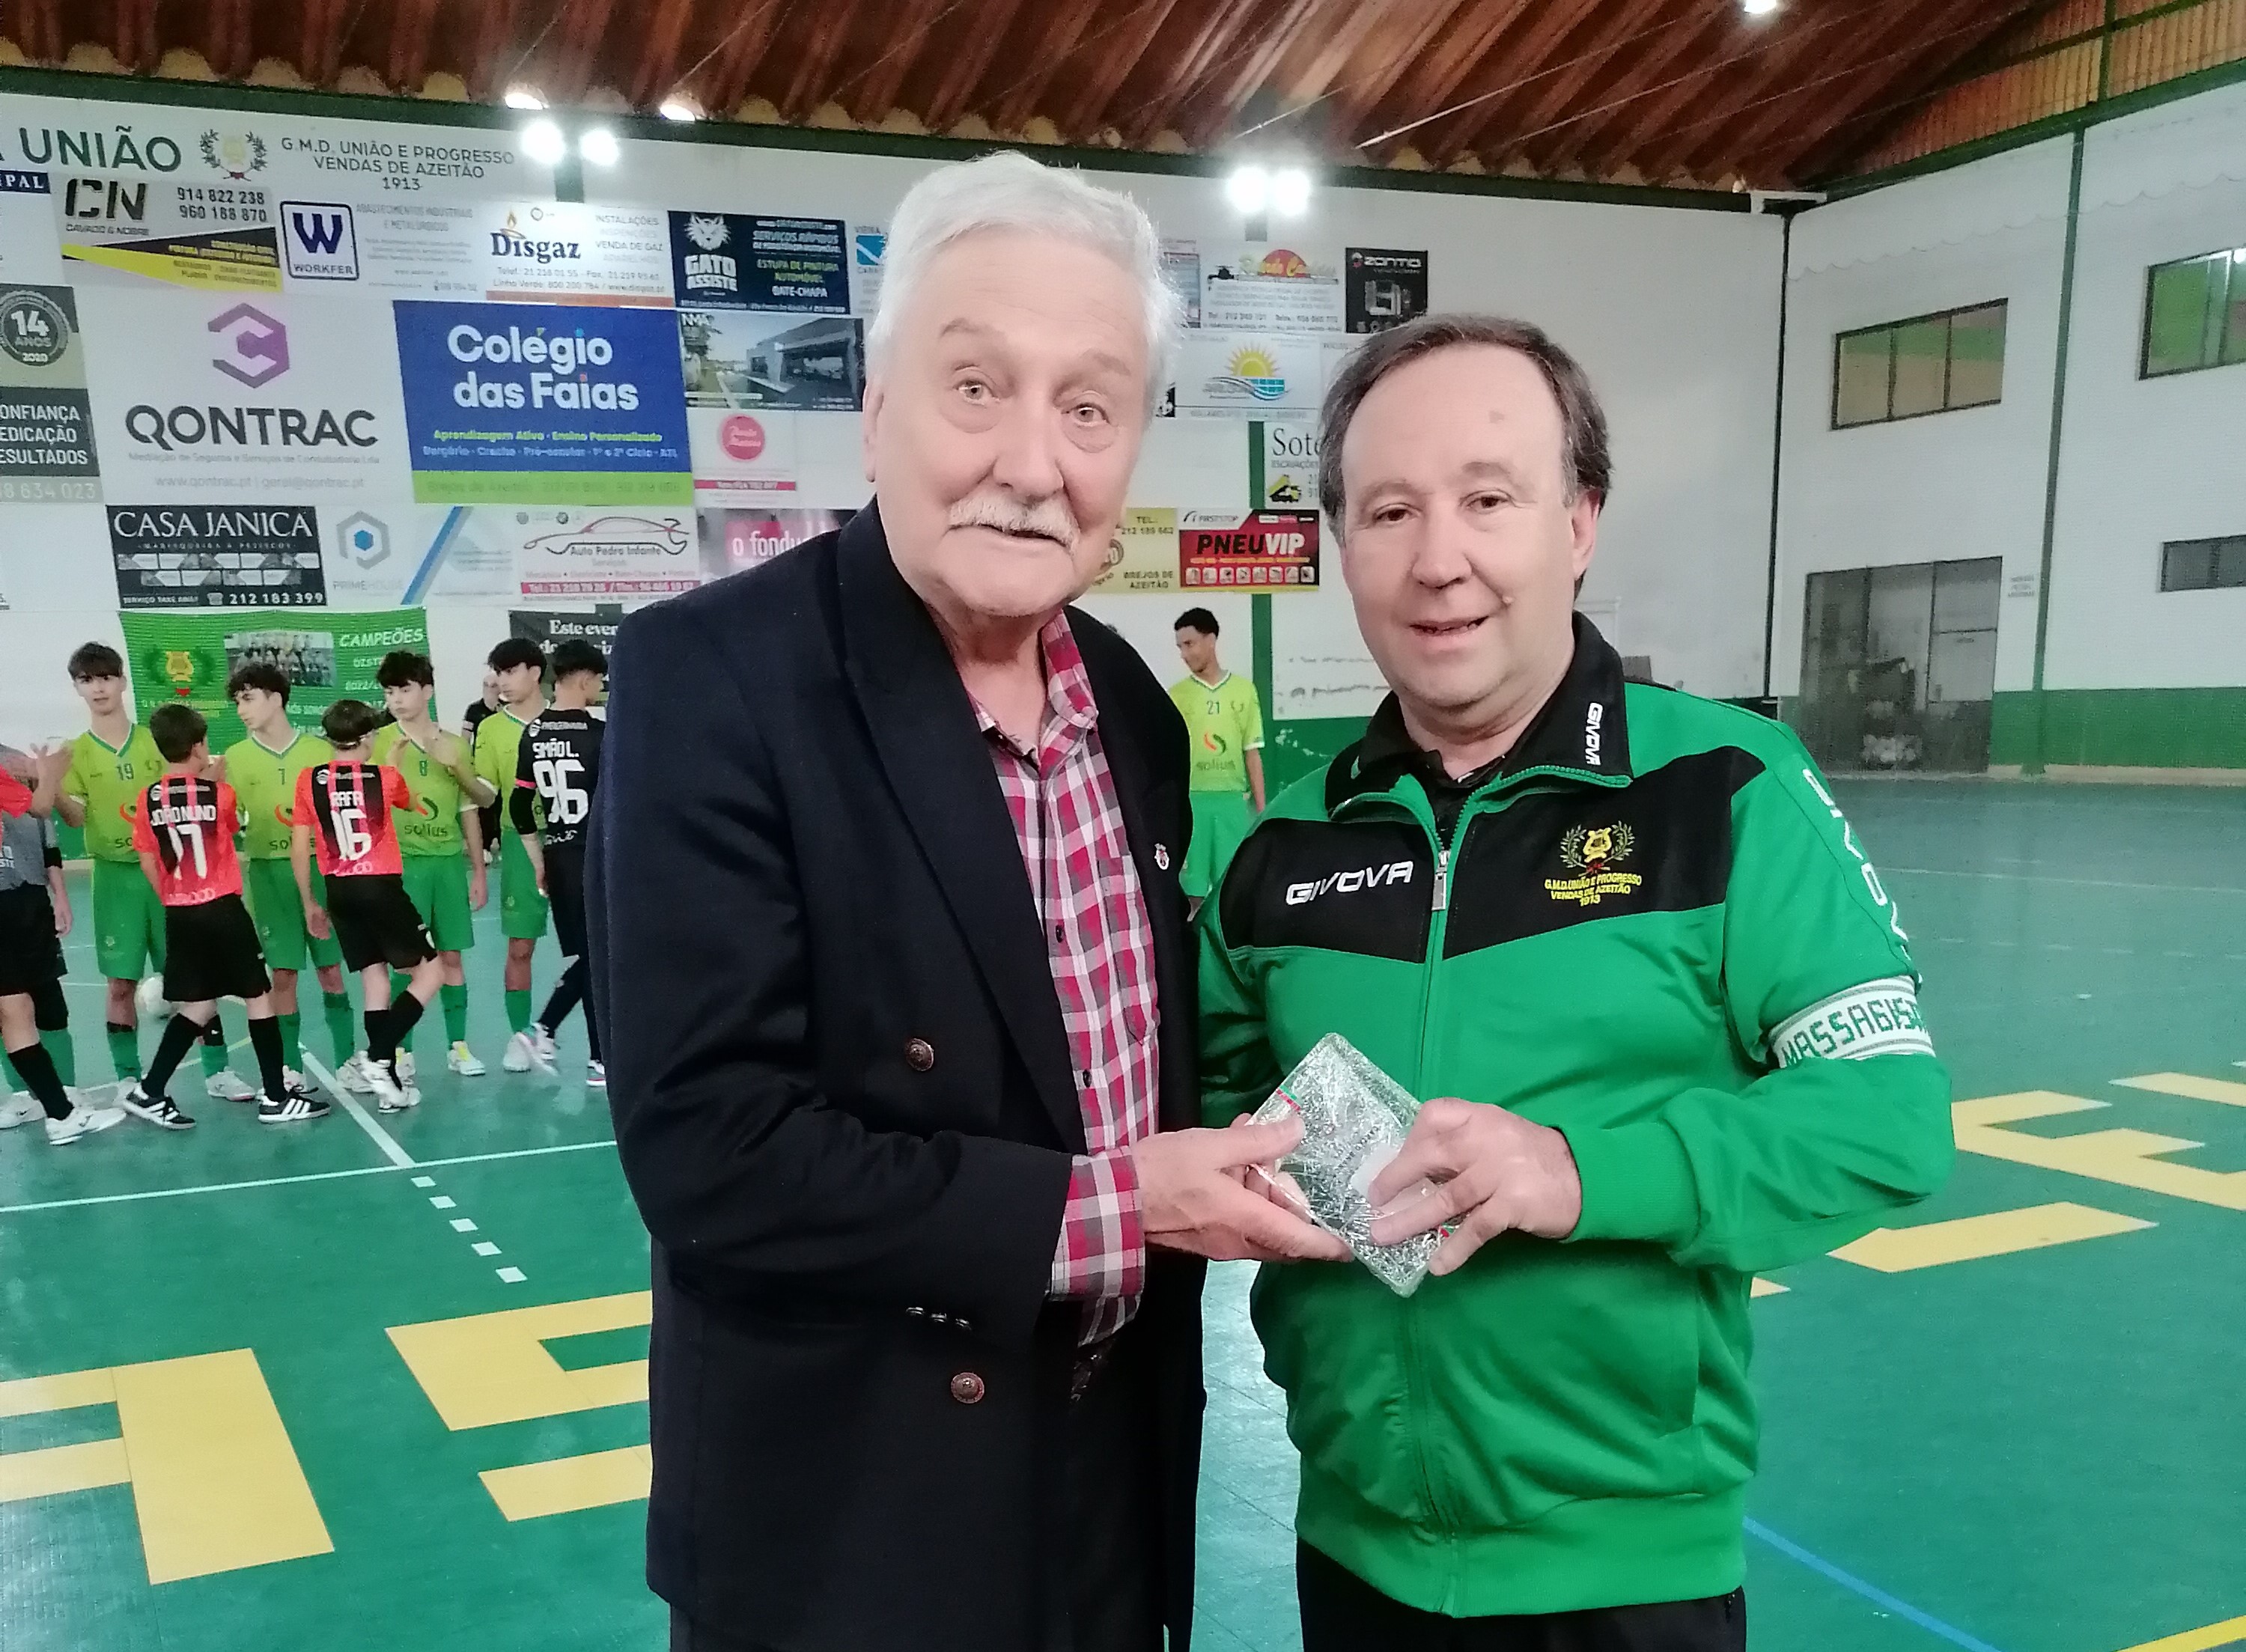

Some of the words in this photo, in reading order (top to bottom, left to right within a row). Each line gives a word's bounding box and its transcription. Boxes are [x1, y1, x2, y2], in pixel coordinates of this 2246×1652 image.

[19, 124, 182, 172] UNIÃO
[340, 140, 393, 157] UNIÃO
[398, 145, 409, 157] E
[413, 146, 514, 164] PROGRESSO
[314, 156, 382, 173] VENDAS
[388, 161, 410, 174] DE
[416, 162, 484, 178] AZEITÃO
[177, 187, 203, 201] 914
[208, 189, 234, 203] 822
[238, 192, 265, 204] 238
[383, 177, 422, 190] 1913
[180, 204, 206, 219] 960
[242, 208, 267, 222] 870
[293, 213, 343, 254] W
[490, 231, 581, 263] Disgaz
[293, 263, 353, 275] WORKFER
[684, 254, 737, 278] GATO
[11, 311, 50, 337] 14
[448, 324, 613, 374] Colégio
[454, 371, 525, 409] das
[530, 372, 639, 410] Faias
[125, 404, 379, 451] QONTRAC
[113, 511, 198, 537] CASA
[204, 511, 314, 537] JANICA
[570, 546, 594, 556] Auto
[1196, 532, 1306, 555] PNEUVIP
[229, 593, 258, 605] 212
[296, 592, 323, 604] 399
[338, 627, 424, 647] CAMPEÕES
[549, 619, 584, 635] Este
[1585, 702, 1604, 766] GIVOVA
[115, 763, 134, 781] 19
[532, 759, 588, 825] 96
[330, 808, 372, 861] 16
[167, 823, 208, 881] 17
[1285, 860, 1414, 906] GIVOVA
[1596, 872, 1643, 886] PROGRESSO
[1550, 890, 1584, 900] VENDAS
[1583, 886, 1595, 896] DE
[1595, 883, 1631, 895] AZEITÃO
[1579, 894, 1601, 907] 1913
